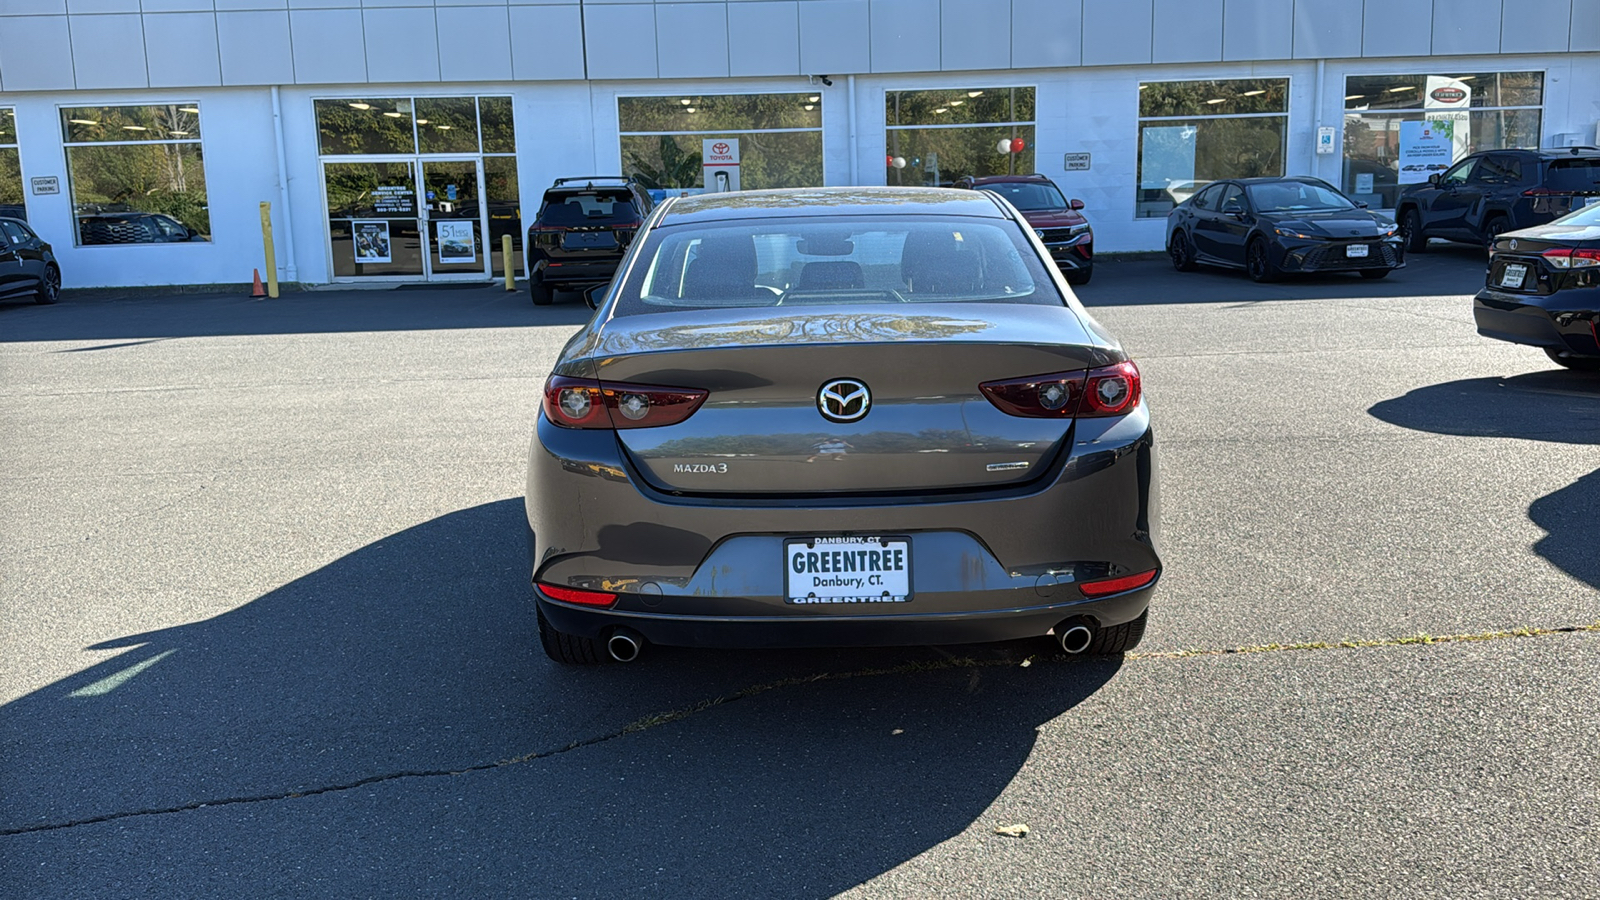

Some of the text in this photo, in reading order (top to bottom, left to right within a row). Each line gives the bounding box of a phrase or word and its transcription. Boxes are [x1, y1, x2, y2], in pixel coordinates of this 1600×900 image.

[442, 225, 455, 238] 51
[673, 462, 728, 474] MAZDA3
[814, 536, 865, 545] DANBURY,
[792, 550, 903, 574] GREENTREE
[813, 574, 884, 589] Danbury, CT.
[793, 596, 906, 604] GREENTREE
